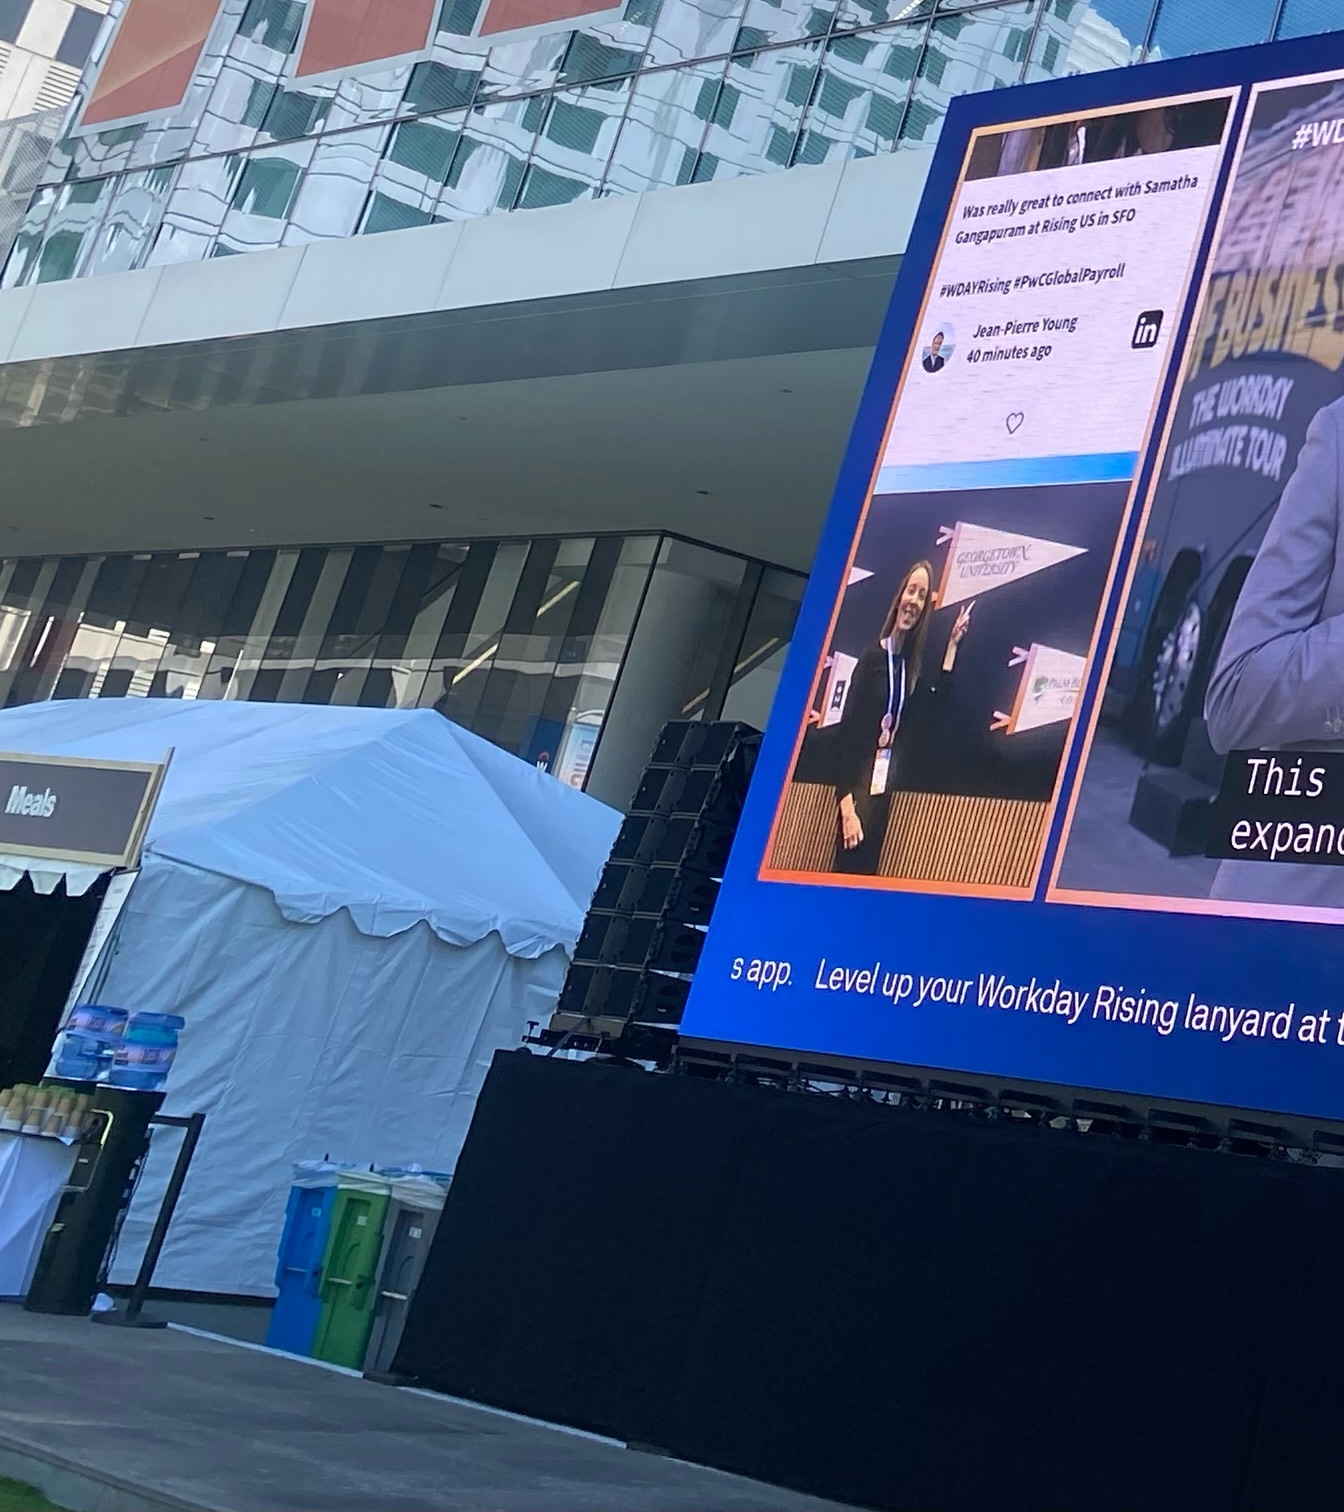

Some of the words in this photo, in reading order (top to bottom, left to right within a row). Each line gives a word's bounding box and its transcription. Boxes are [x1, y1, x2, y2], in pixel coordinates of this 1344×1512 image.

[962, 203, 985, 221] Was
[986, 197, 1019, 218] really
[1019, 193, 1051, 215] great
[1052, 192, 1064, 208] to
[1066, 185, 1113, 207] connect
[1114, 181, 1142, 199] with
[1144, 174, 1199, 195] Samatha
[955, 222, 1026, 246] Gangapuram
[1027, 219, 1041, 236] at
[1041, 214, 1078, 235] Rising
[1079, 212, 1097, 229] US
[1097, 210, 1110, 227] in
[1110, 207, 1136, 225] SFO
[939, 276, 1013, 299] #WDAYRising
[1012, 262, 1126, 291] #PwCGlobalPayroll
[972, 319, 1040, 340] Jean-Pierre
[1042, 314, 1079, 335] Young
[1133, 316, 1158, 346] in
[966, 348, 980, 364] 40
[982, 345, 1030, 363] minutes
[1030, 344, 1052, 361] ago
[1189, 379, 1222, 430] THE
[1217, 373, 1295, 422] WORKDAY
[1245, 426, 1288, 483] TOUR
[1244, 756, 1325, 799] This
[4, 784, 58, 819] Meals
[746, 960, 793, 992] app.
[815, 958, 880, 995] Level
[882, 971, 913, 1001] up
[912, 975, 973, 1008] your
[976, 973, 1090, 1025] Workday
[1093, 985, 1178, 1035] Rising
[1184, 992, 1295, 1043] lanyard
[1297, 1009, 1329, 1045] at
